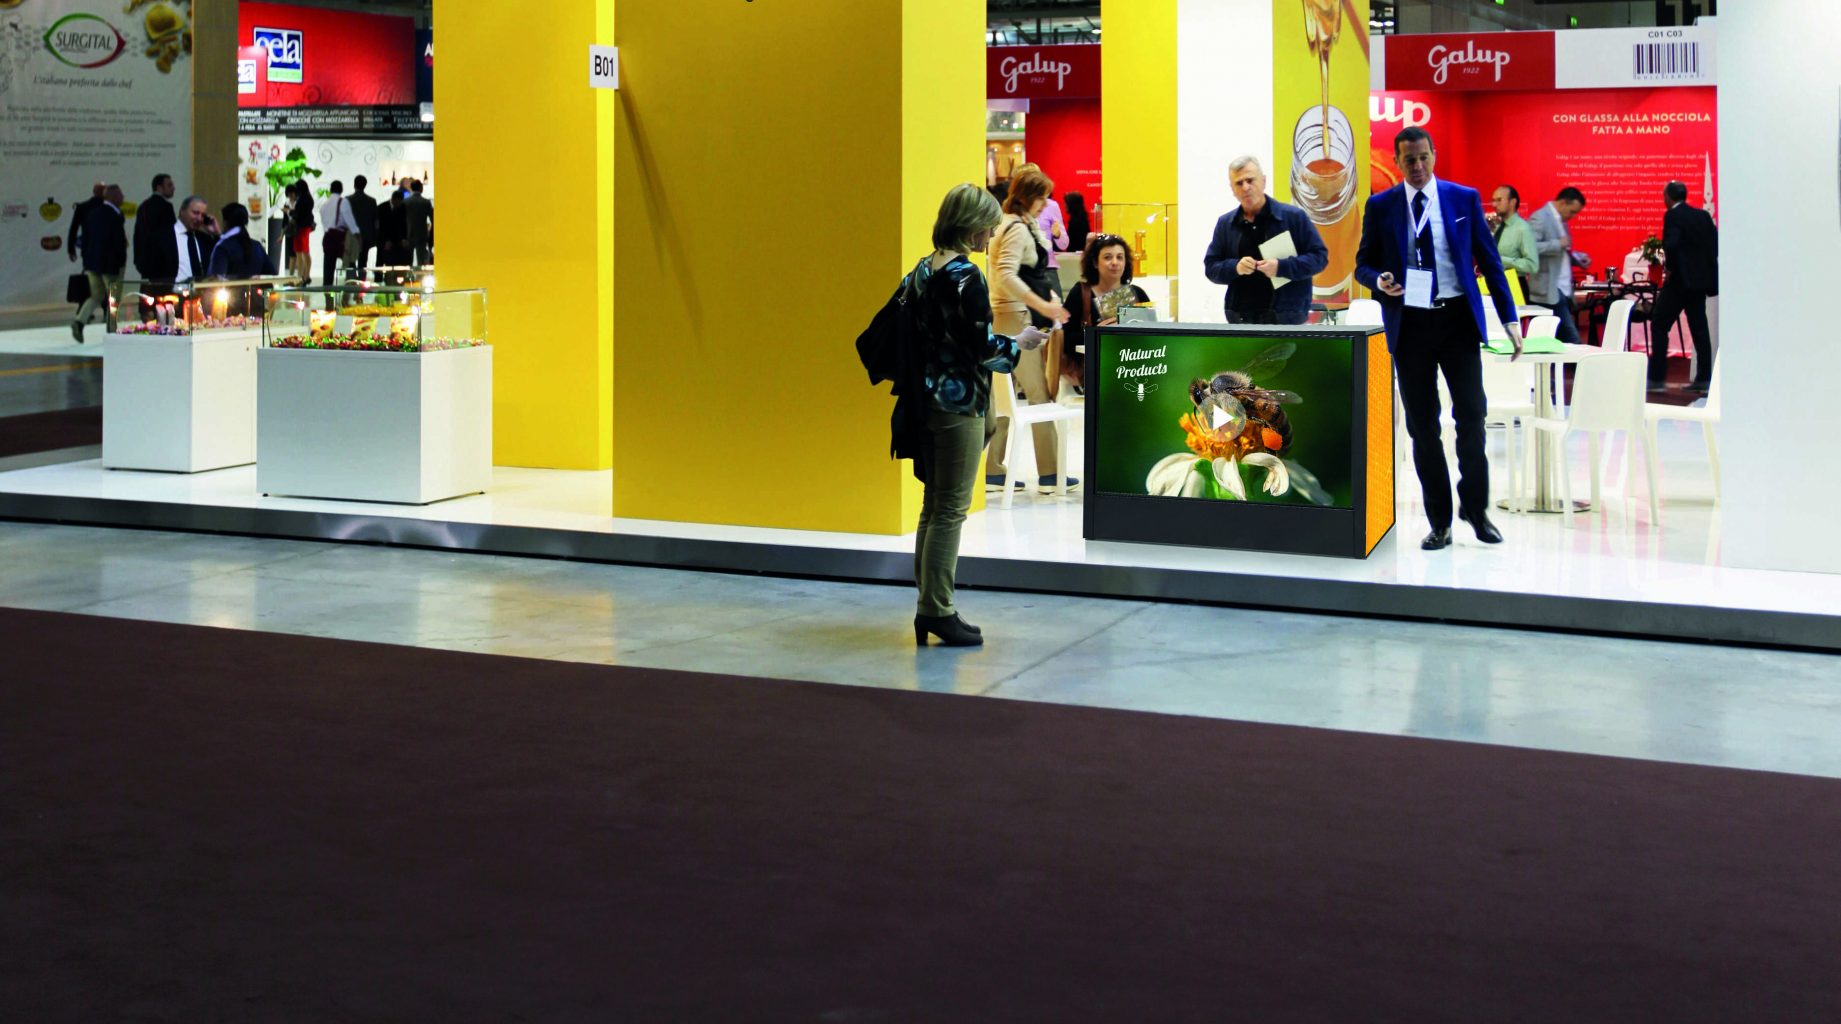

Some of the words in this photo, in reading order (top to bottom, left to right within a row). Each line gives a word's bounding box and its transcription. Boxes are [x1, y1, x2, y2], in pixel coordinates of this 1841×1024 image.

[55, 30, 113, 50] SURGITAL
[1666, 30, 1683, 38] C03
[594, 55, 614, 77] B01
[1428, 39, 1511, 85] Galup
[1000, 51, 1072, 93] Galup
[1552, 114, 1577, 123] CON
[1579, 114, 1620, 123] GLASSA
[1622, 113, 1649, 122] ALLA
[1652, 112, 1711, 122] NOCCIOLA
[1592, 125, 1624, 134] FATTA
[1626, 125, 1634, 134] A
[1636, 125, 1670, 134] MANO
[1119, 345, 1167, 362] Natural
[1116, 362, 1168, 379] Products
